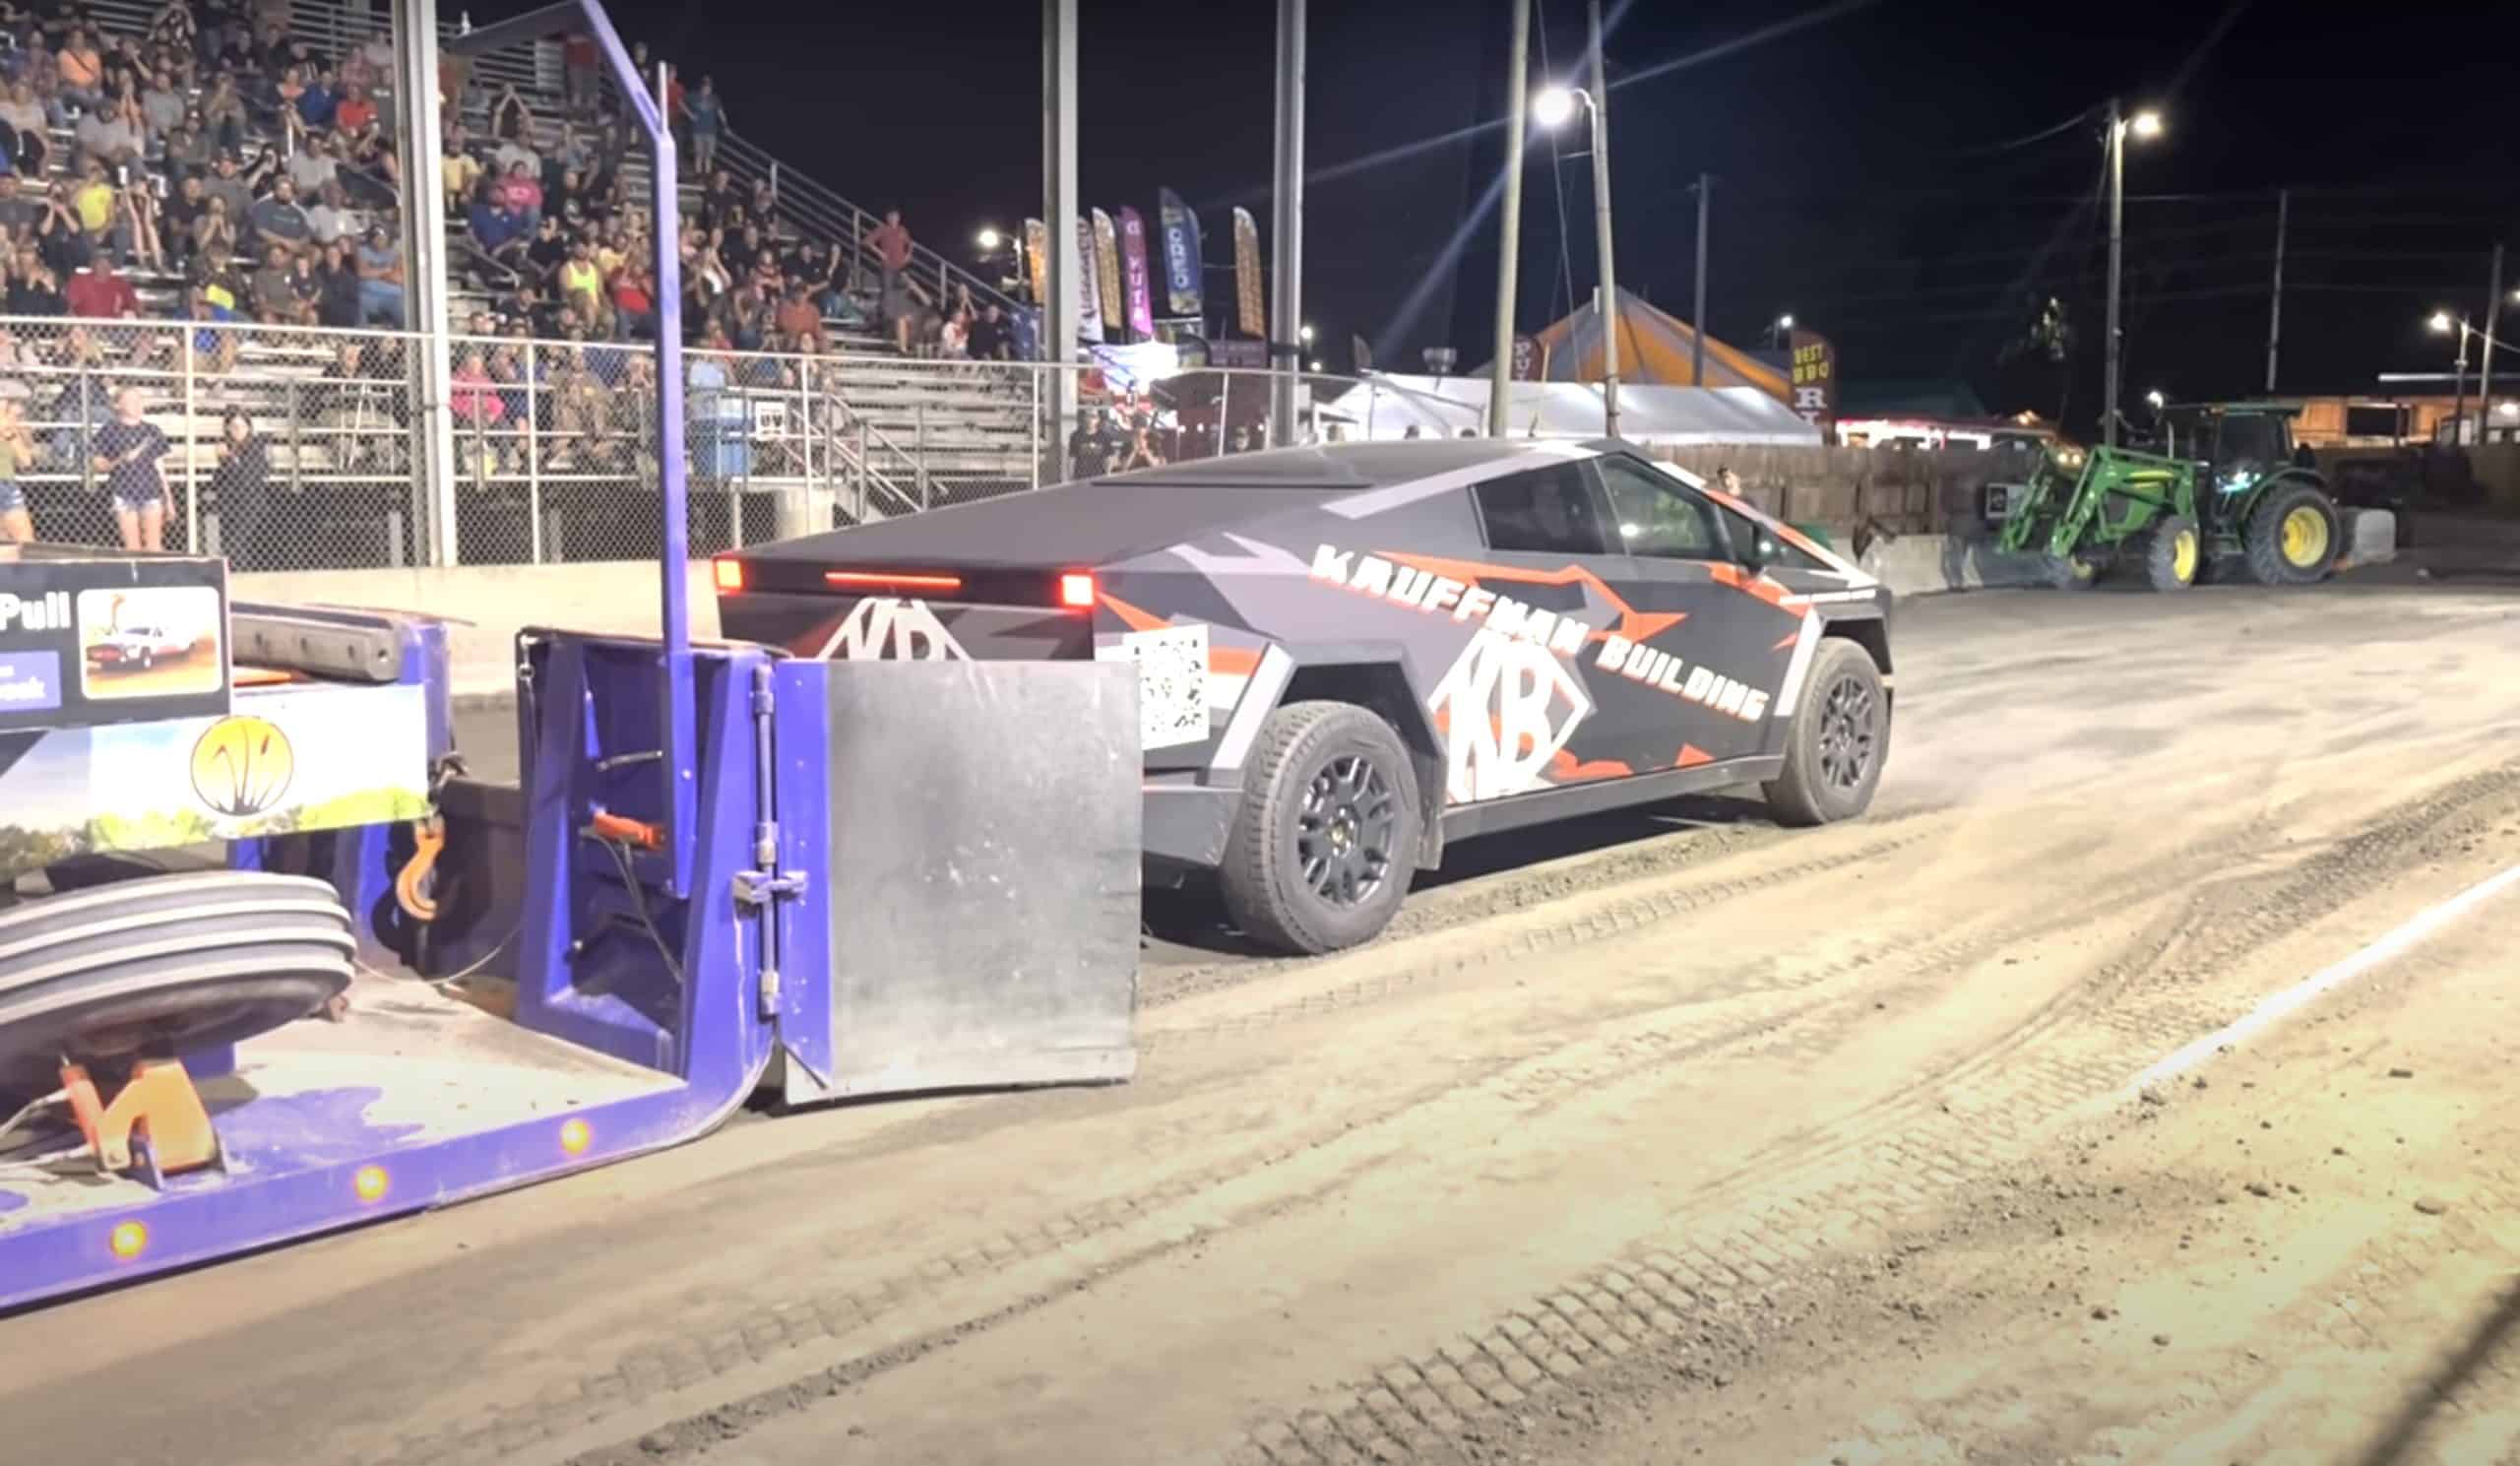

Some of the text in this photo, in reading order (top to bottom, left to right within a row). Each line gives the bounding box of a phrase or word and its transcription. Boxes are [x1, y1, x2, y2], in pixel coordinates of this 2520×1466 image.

[0, 591, 72, 631] Pull
[1310, 543, 1770, 722] KAUFFMAN BUILDING
